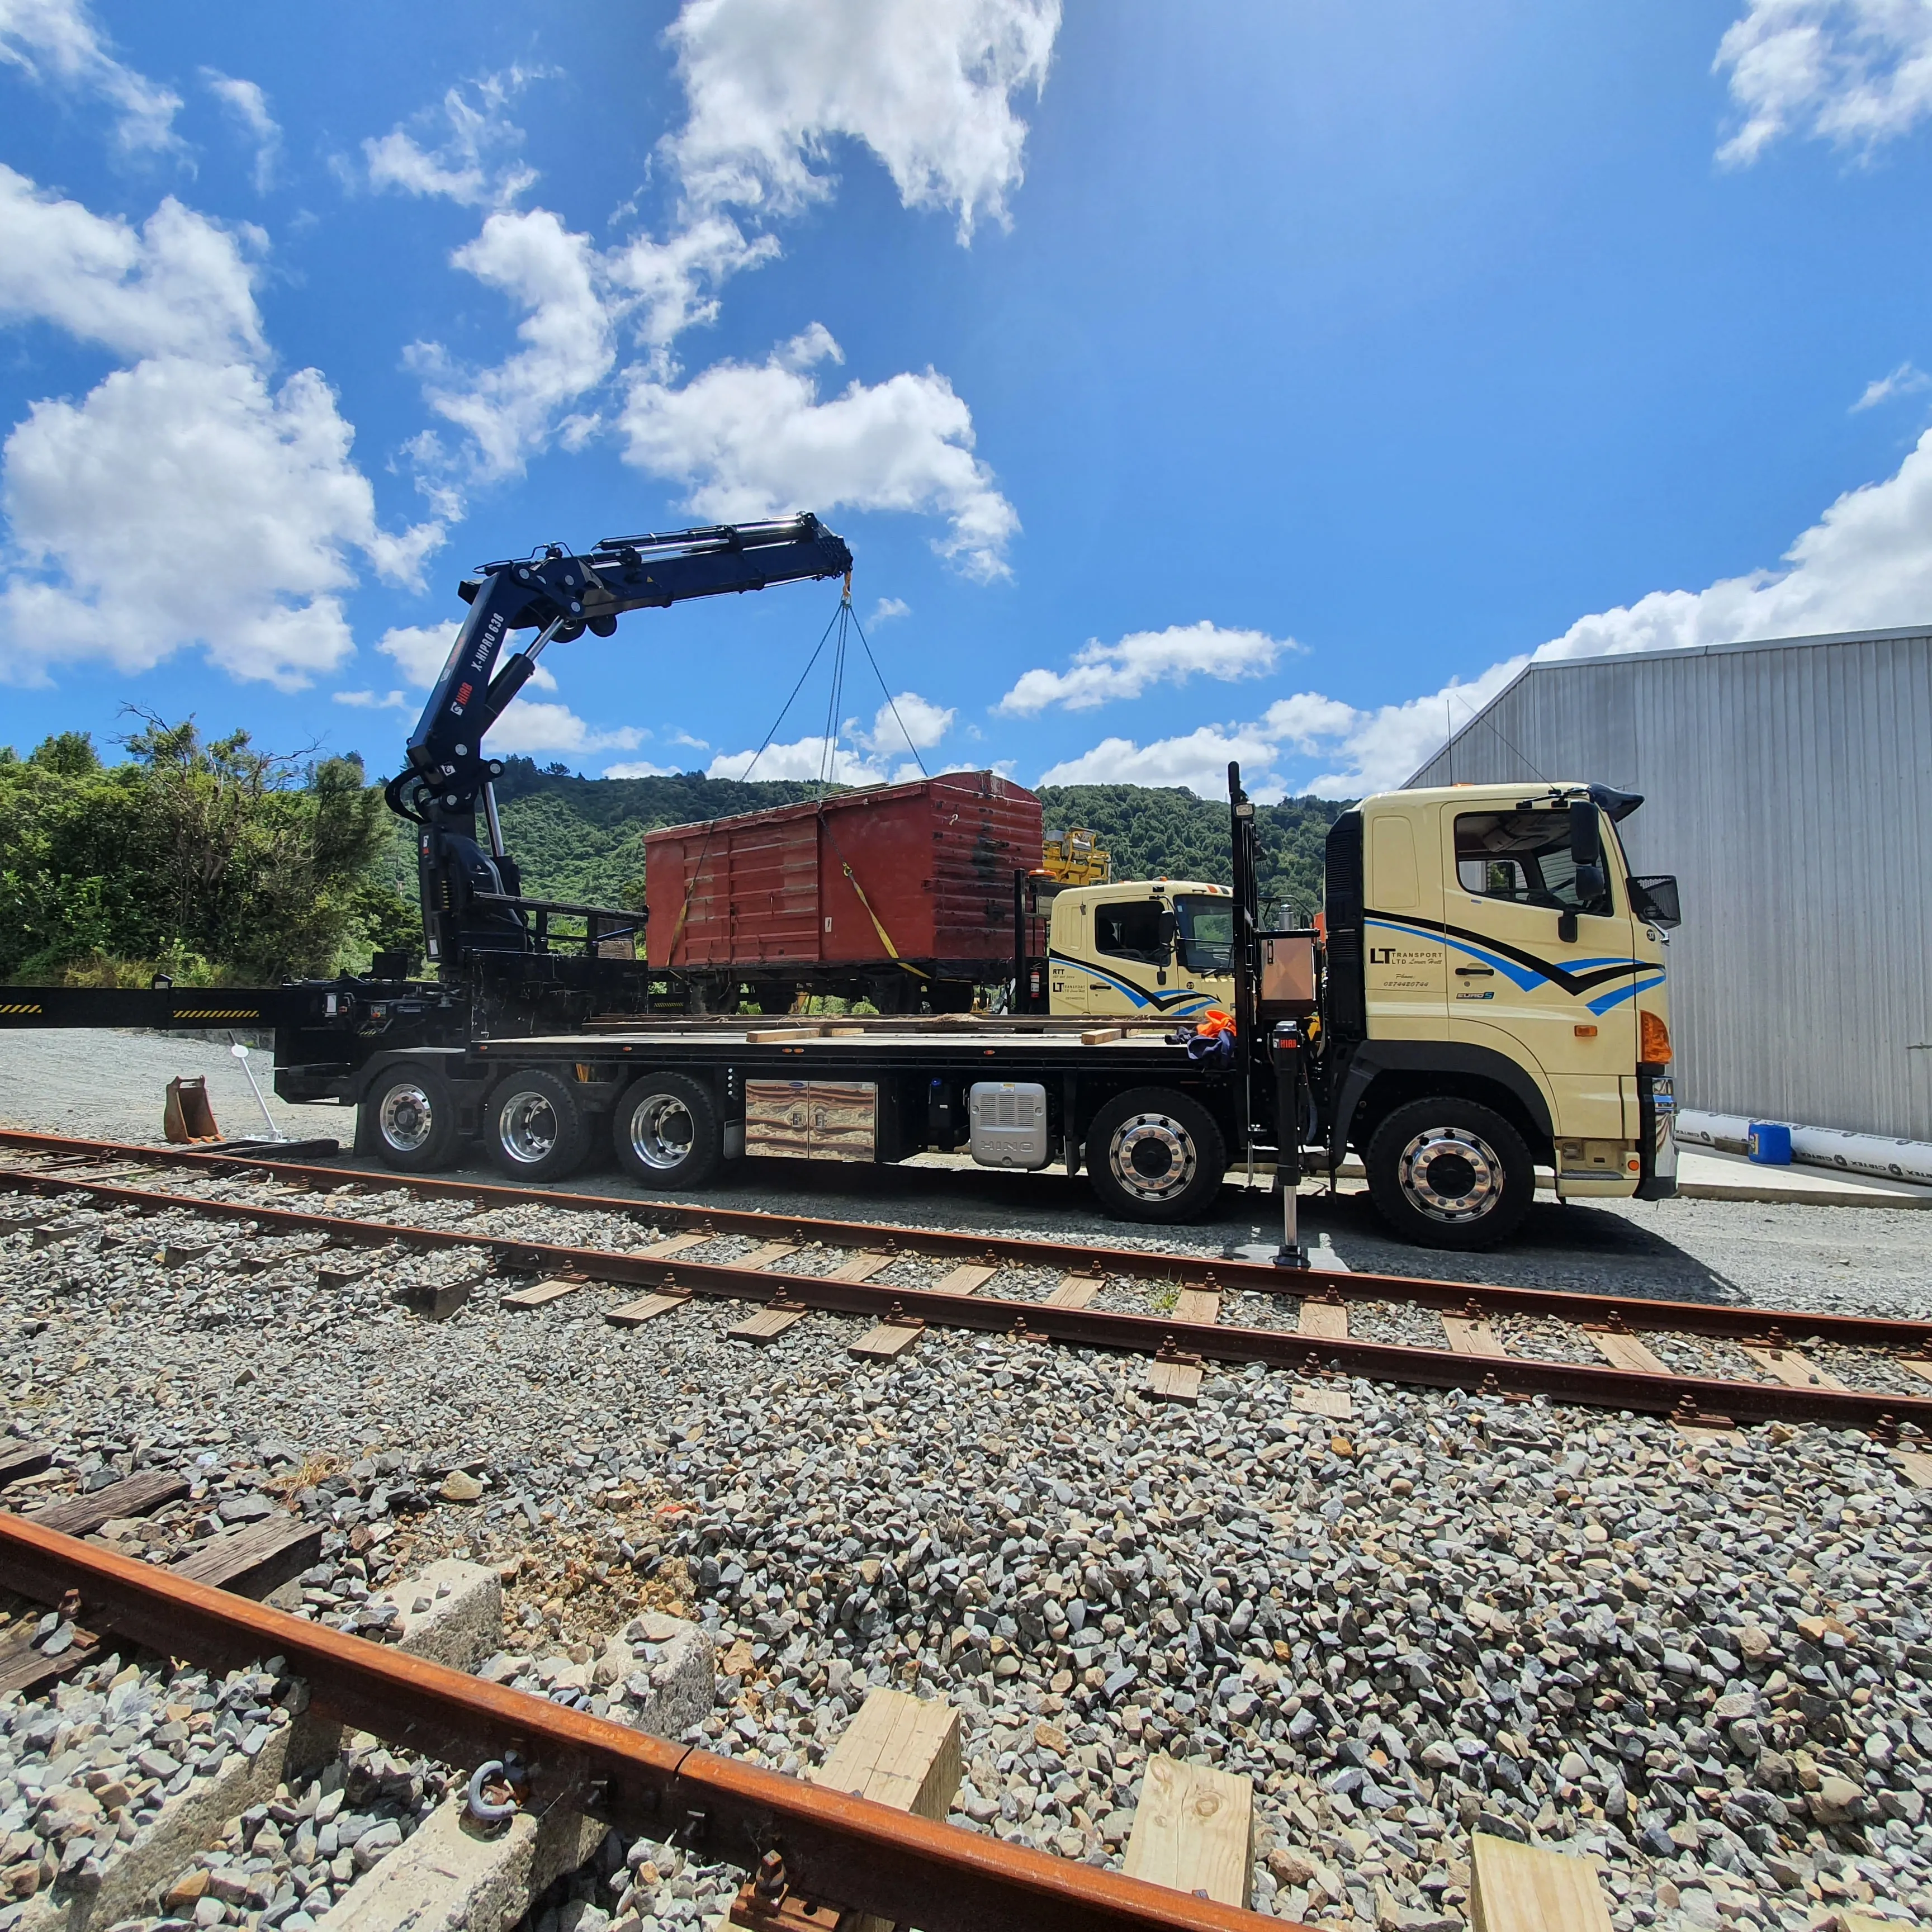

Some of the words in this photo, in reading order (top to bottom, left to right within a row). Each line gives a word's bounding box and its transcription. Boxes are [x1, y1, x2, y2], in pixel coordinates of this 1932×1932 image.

[471, 632, 495, 672] X-HIPRO
[488, 613, 504, 633] 638
[456, 681, 473, 705] HIAB
[1370, 948, 1396, 964] LT
[1053, 982, 1064, 992] LT
[1280, 1039, 1297, 1048] HIAB
[981, 1141, 1034, 1152] HINO
[1851, 1161, 1887, 1171] CIRTEX
